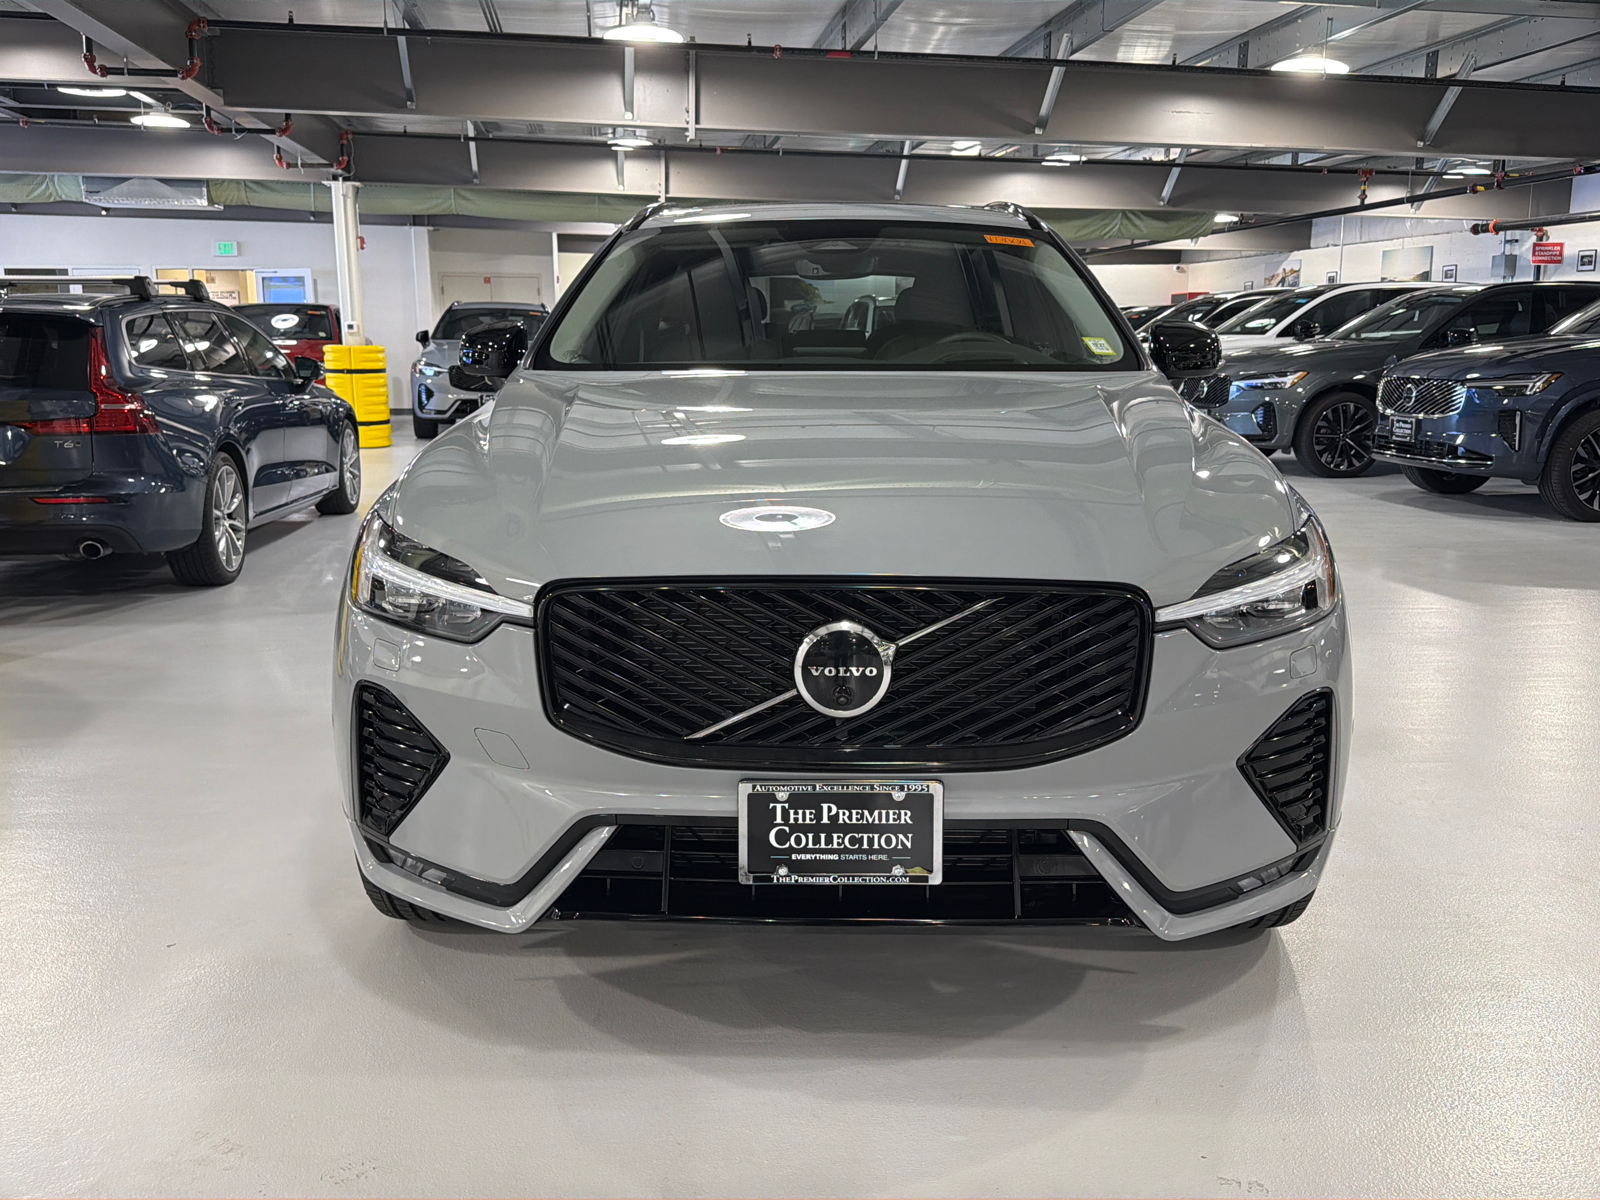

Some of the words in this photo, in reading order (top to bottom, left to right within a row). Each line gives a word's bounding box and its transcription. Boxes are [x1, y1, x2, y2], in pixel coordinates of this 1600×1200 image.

[217, 242, 234, 255] EXIT
[807, 666, 878, 677] VOLVO
[753, 784, 813, 792] AUTOMOTIVE
[815, 784, 872, 792] EXCELLENCE
[873, 784, 900, 792] SINCE
[902, 784, 928, 792] 1995
[769, 802, 816, 824] THE
[819, 803, 914, 825] PREMIER
[768, 825, 914, 849] COLLECTION
[791, 853, 839, 861] EVERYTHING
[840, 853, 868, 861] STARTS
[770, 874, 910, 884] THEPREMIERCOLLECTION.COM
